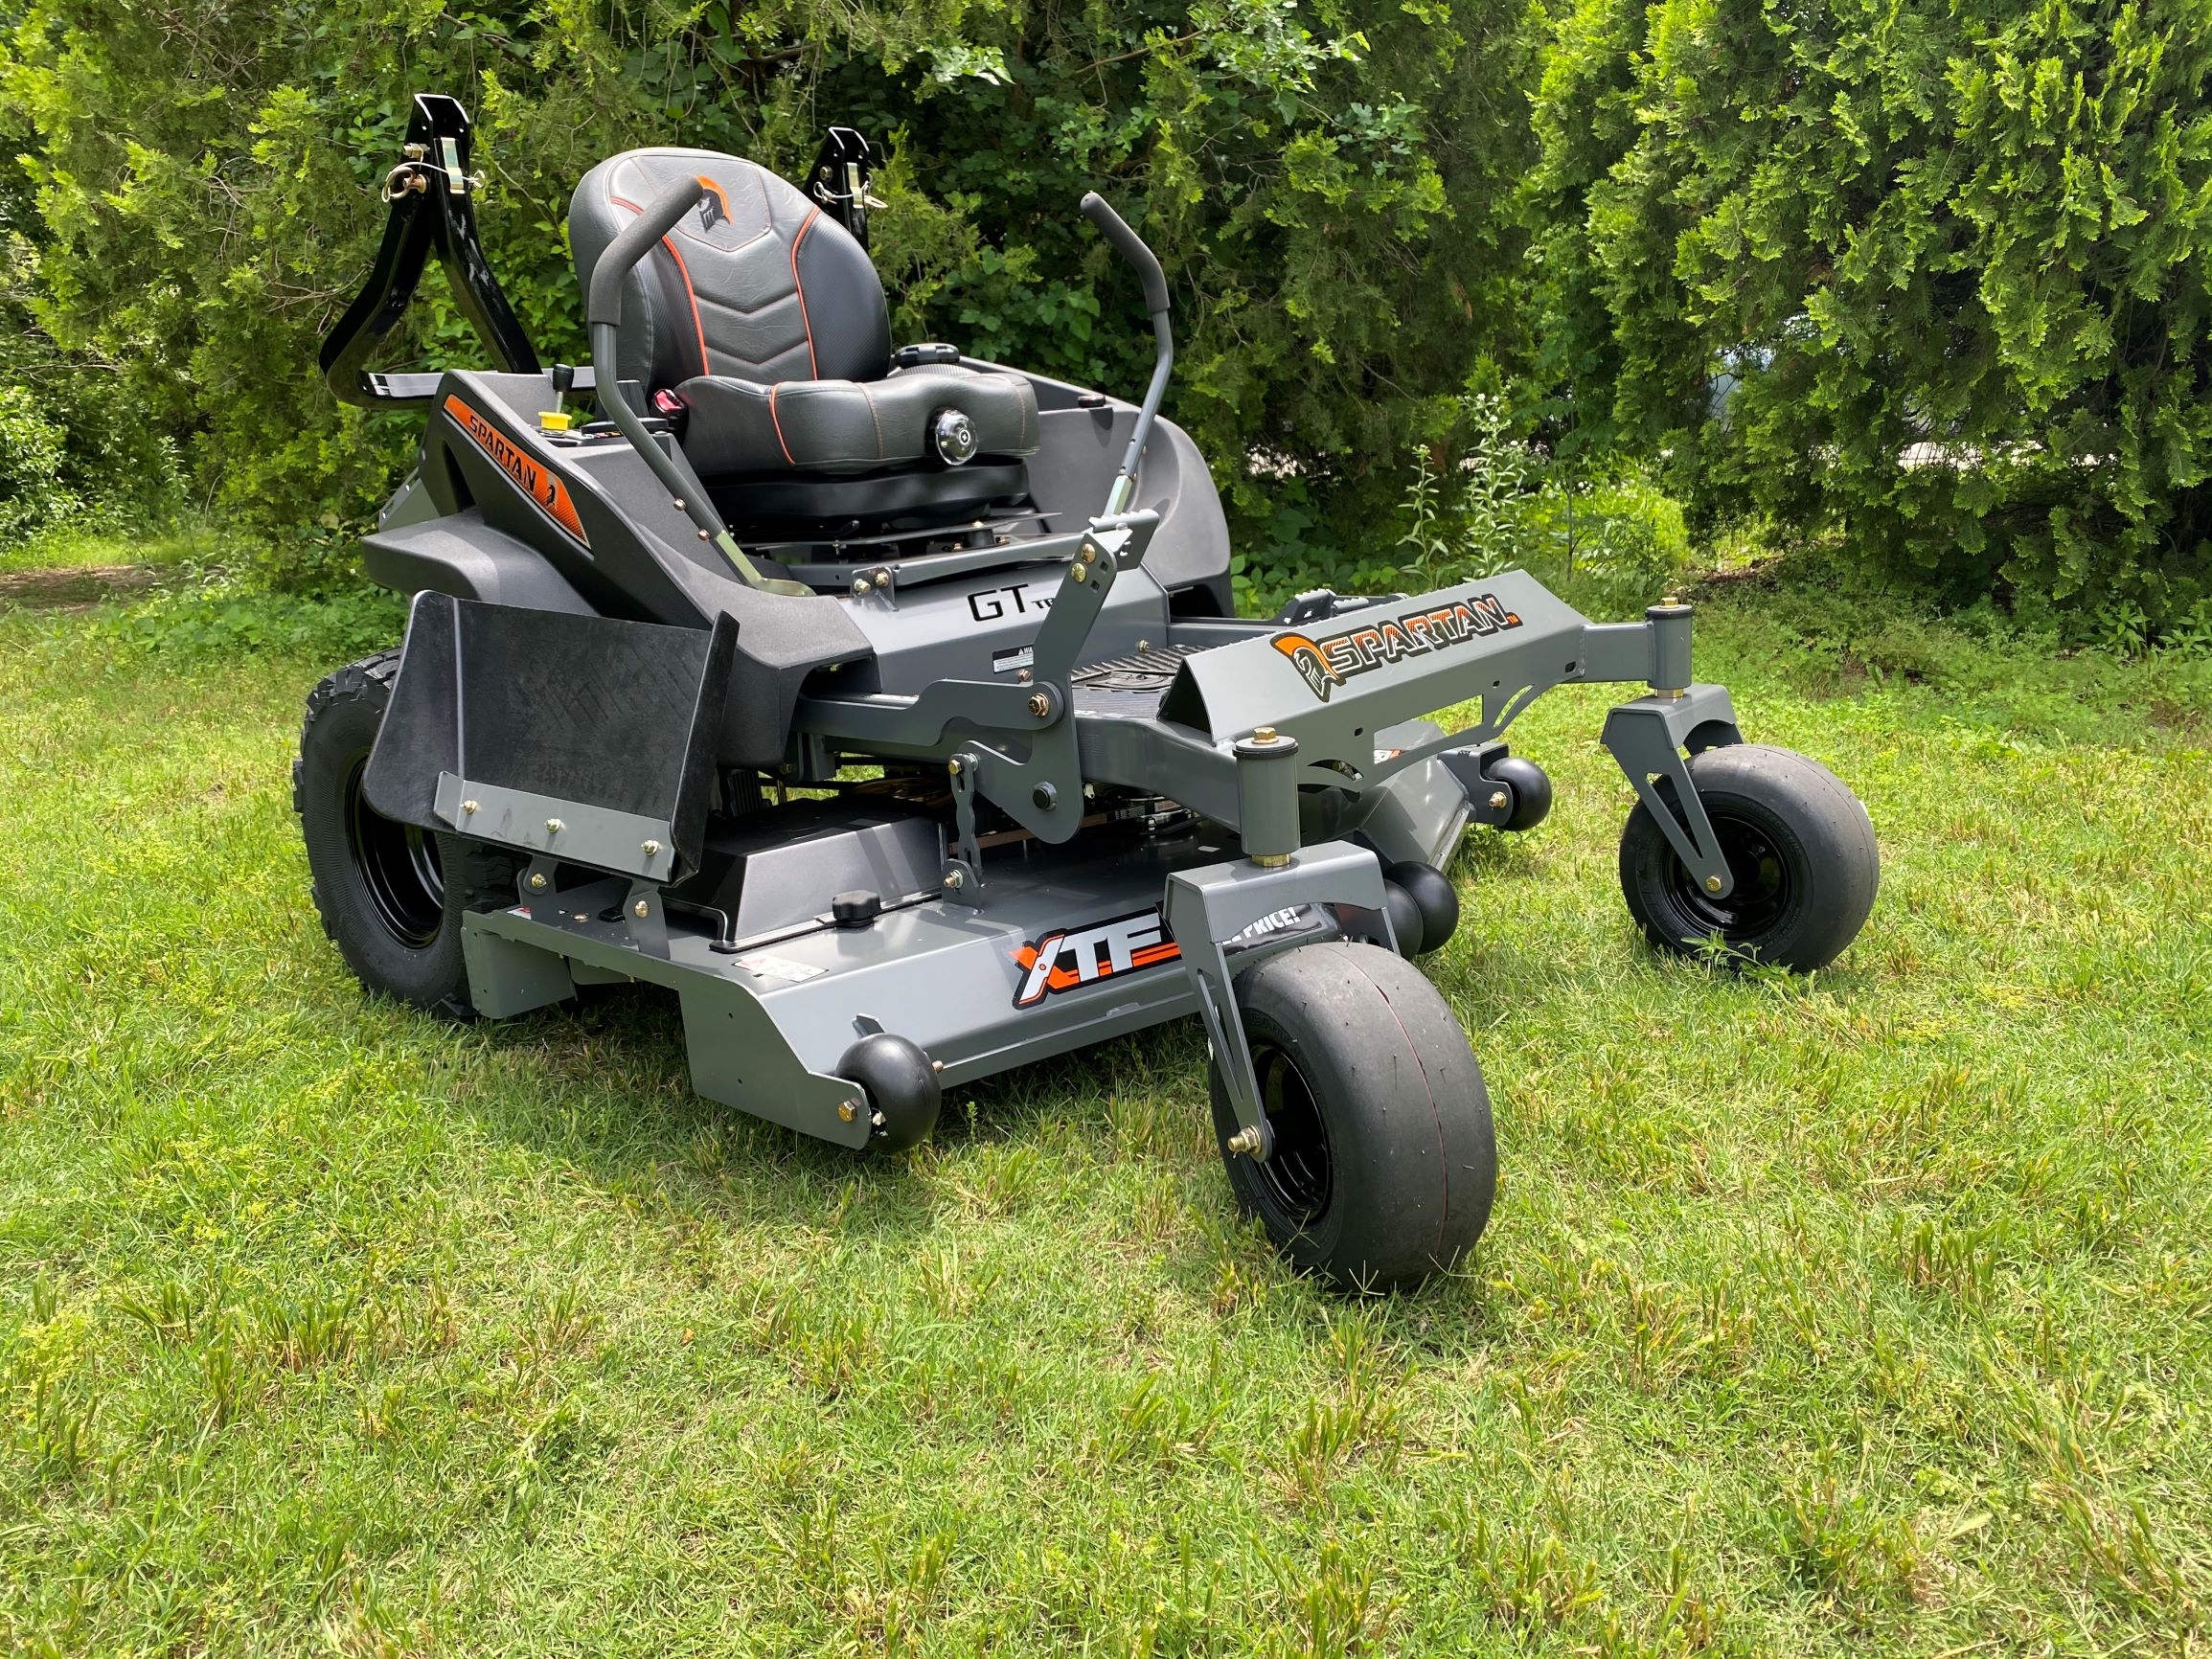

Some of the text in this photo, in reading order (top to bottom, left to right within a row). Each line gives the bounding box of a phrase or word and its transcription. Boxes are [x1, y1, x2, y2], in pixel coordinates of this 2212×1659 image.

[468, 415, 537, 492] SPARTAN
[968, 583, 1029, 622] GT
[1319, 595, 1508, 674] SPARTAN
[1010, 911, 1162, 1006] XTF
